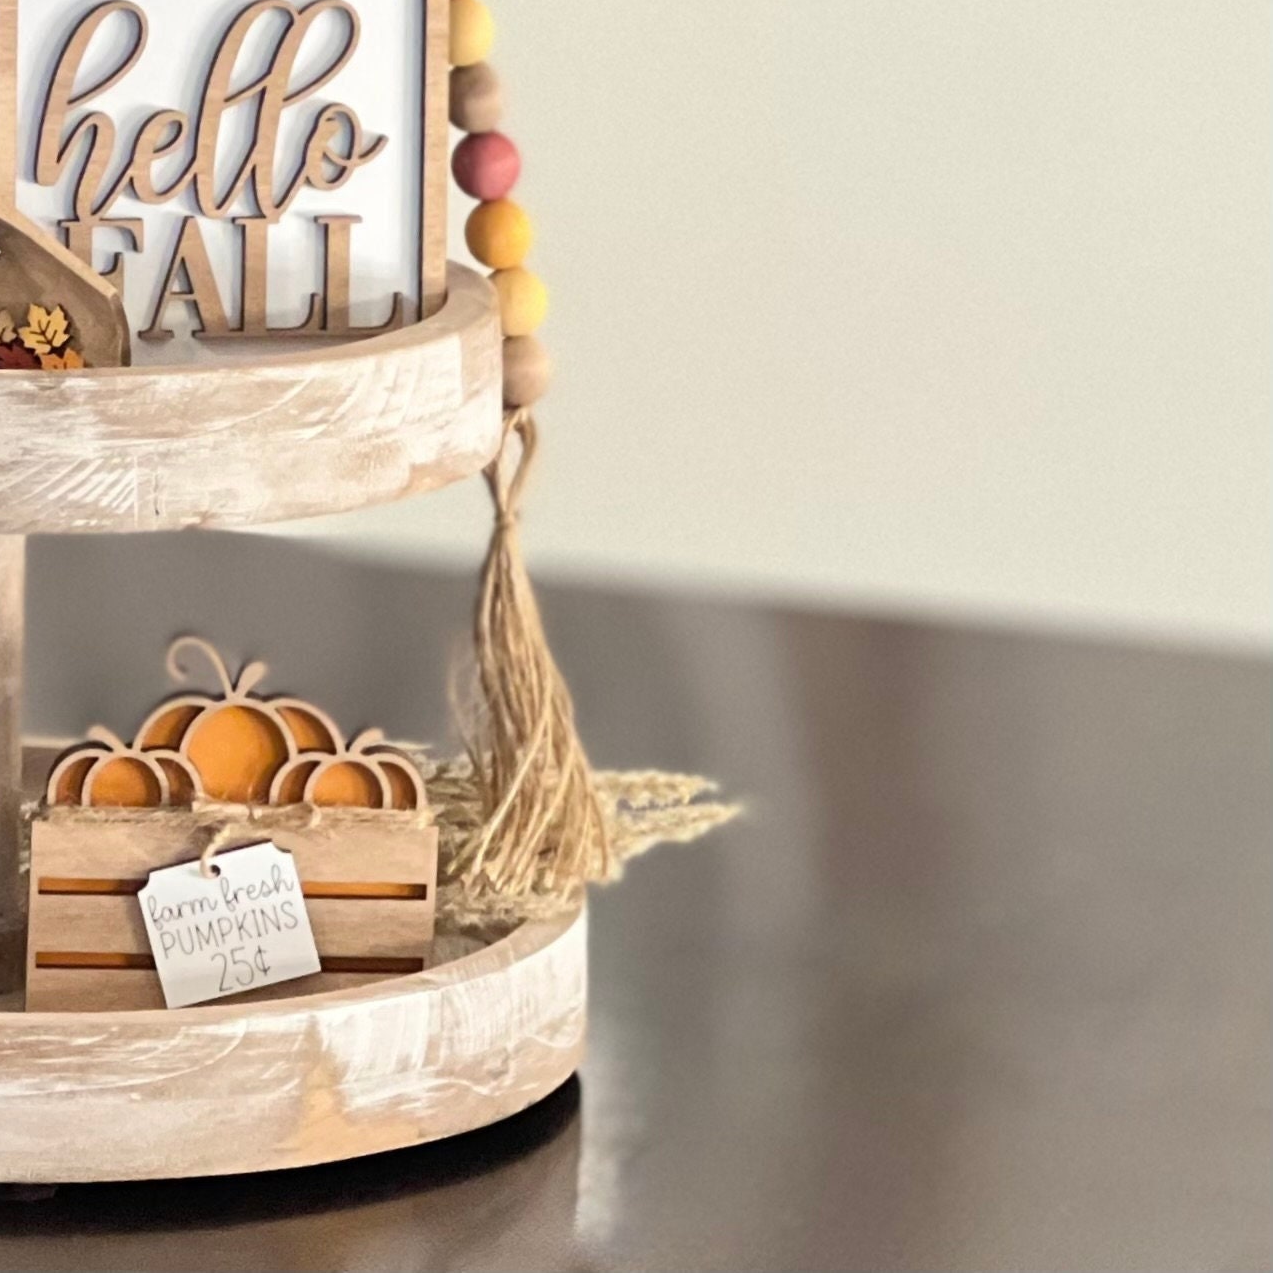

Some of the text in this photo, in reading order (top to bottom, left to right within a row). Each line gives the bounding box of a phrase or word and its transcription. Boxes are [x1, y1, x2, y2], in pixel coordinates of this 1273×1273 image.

[57, 214, 407, 340] FALL
[146, 863, 295, 932] farm fresh
[158, 900, 299, 960] PUMPKINS
[210, 944, 272, 993] 25¢
